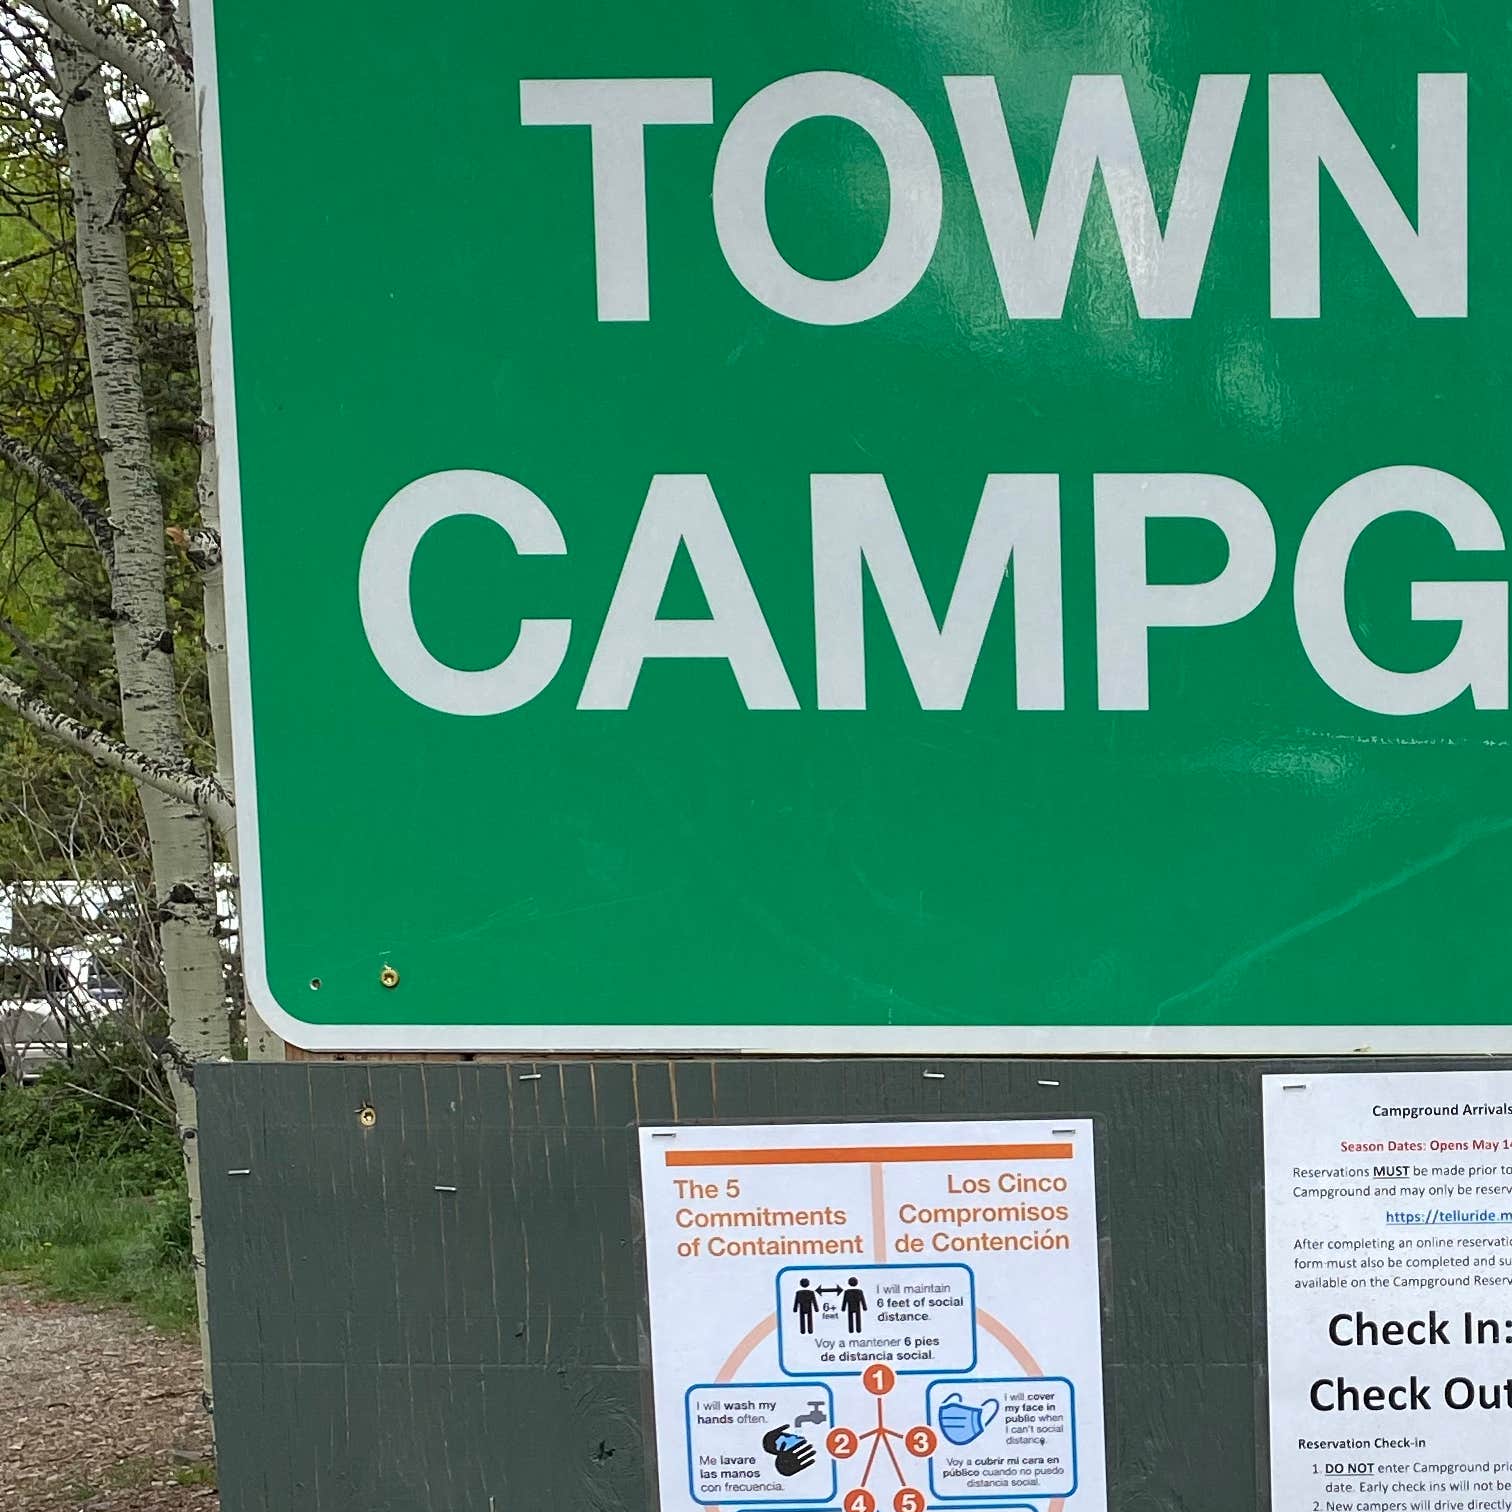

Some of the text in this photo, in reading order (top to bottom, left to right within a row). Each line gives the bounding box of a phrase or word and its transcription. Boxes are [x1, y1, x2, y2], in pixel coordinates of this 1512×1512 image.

[520, 70, 1469, 325] TOWN
[1372, 1103, 1459, 1119] Campground
[1340, 1141, 1384, 1153] Season
[1429, 1139, 1469, 1153] Opens
[1472, 1139, 1500, 1153] May
[1293, 1167, 1370, 1178] Reservations
[1373, 1165, 1411, 1180] MUST
[1413, 1165, 1429, 1177] be
[1431, 1164, 1465, 1176] made
[1468, 1166, 1498, 1179] prior
[673, 1179, 740, 1199] The 5
[947, 1173, 1067, 1194] Los Cinco
[675, 1206, 847, 1229] Commitments
[899, 1201, 1069, 1228] Compromisos
[677, 1235, 864, 1257] of Containment
[894, 1228, 1070, 1253] de Contención
[1329, 1311, 1450, 1346] Check
[1465, 1312, 1512, 1344] In:
[871, 1369, 883, 1390] 1
[1310, 1376, 1431, 1411] Check
[703, 1401, 721, 1411] will
[723, 1400, 756, 1411] wash
[758, 1401, 777, 1412] my
[697, 1414, 734, 1425] hands
[834, 1434, 850, 1454] 2
[913, 1432, 929, 1452] 3
[1298, 1437, 1426, 1450] Reservation Check-in
